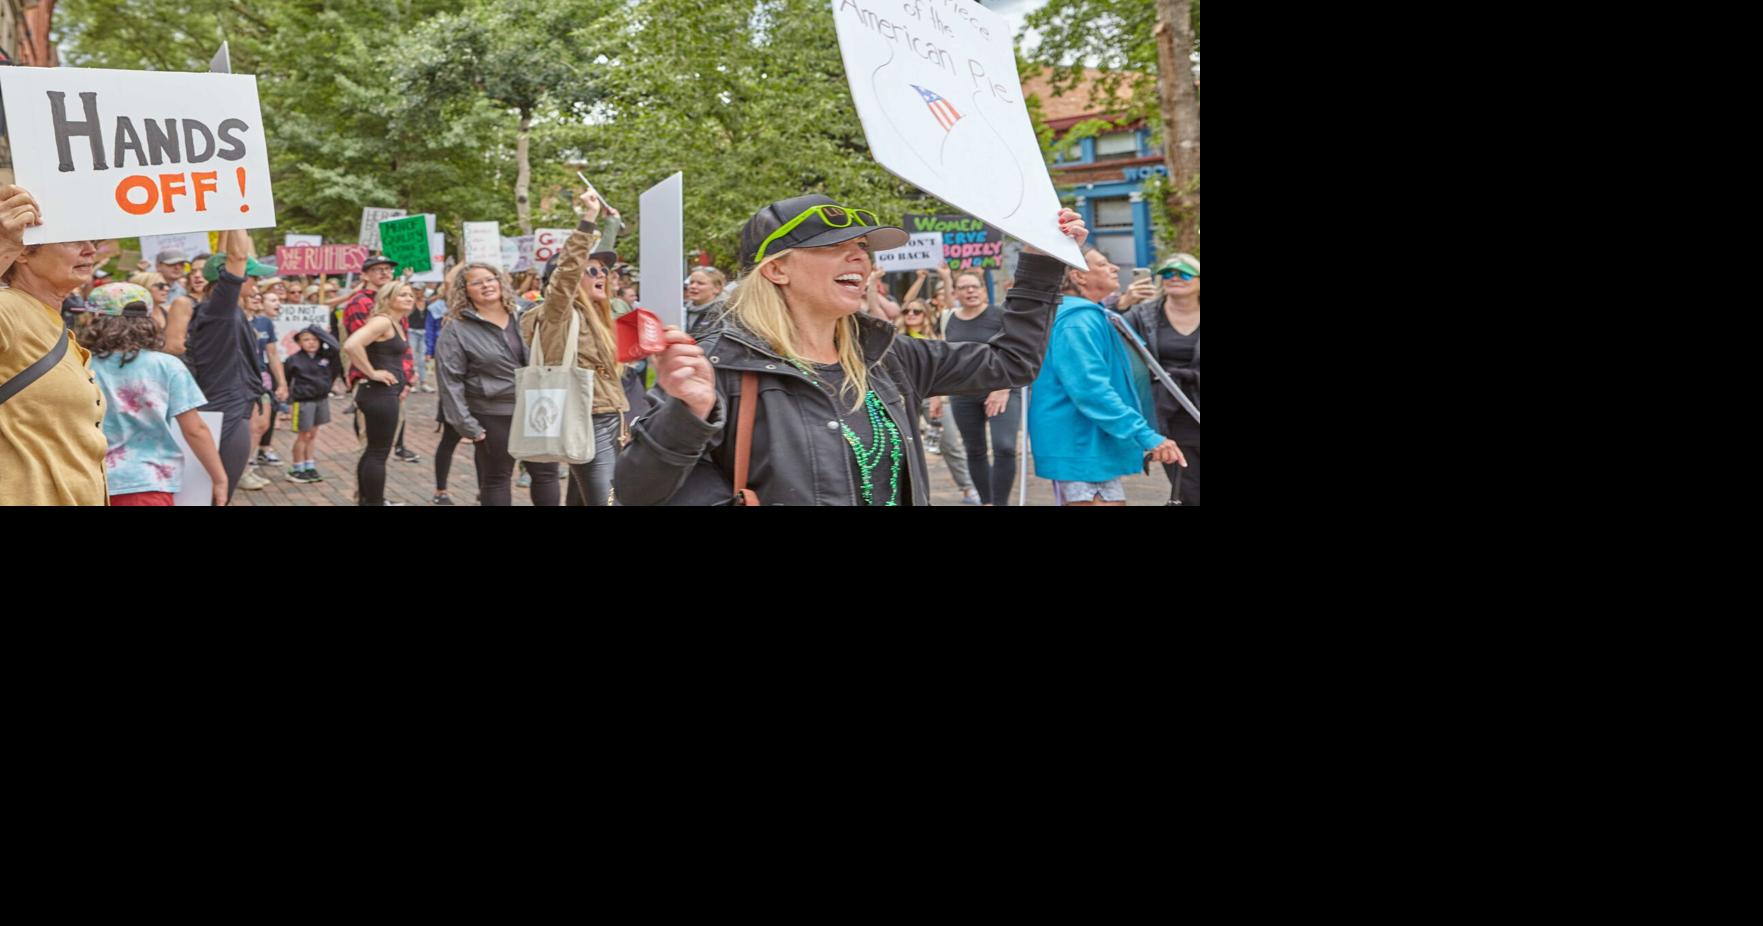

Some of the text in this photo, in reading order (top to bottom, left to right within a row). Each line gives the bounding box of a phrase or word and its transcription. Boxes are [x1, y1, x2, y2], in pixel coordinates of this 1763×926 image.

[903, 0, 922, 21] of
[839, 0, 1014, 104] American Pie
[46, 90, 249, 172] HANDS
[879, 250, 931, 261] GO BACK
